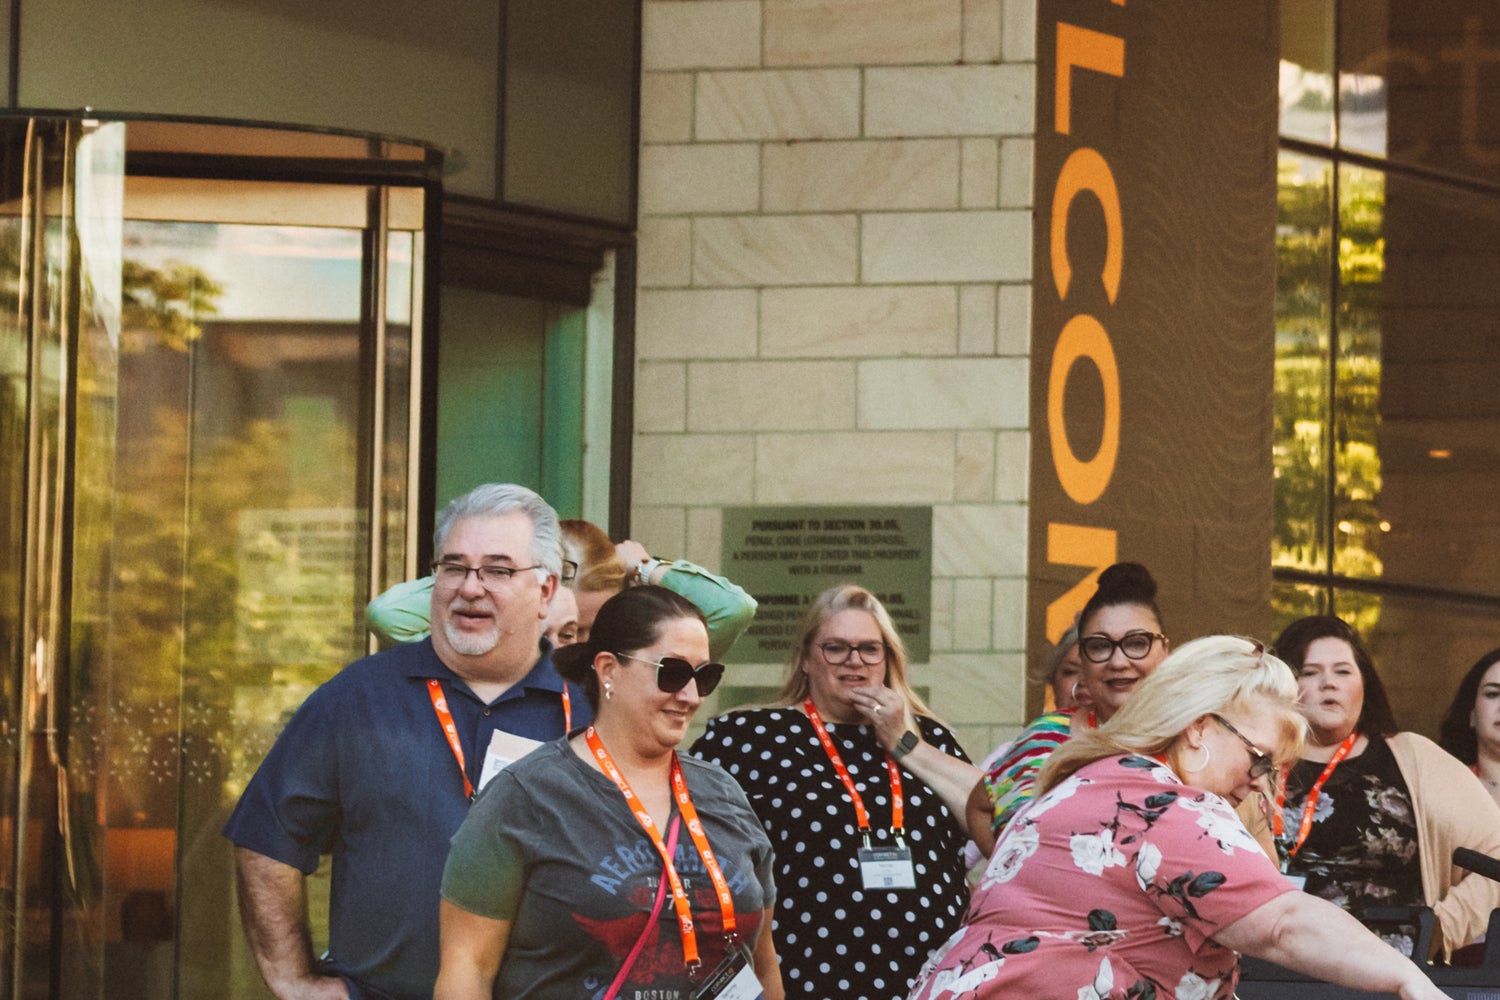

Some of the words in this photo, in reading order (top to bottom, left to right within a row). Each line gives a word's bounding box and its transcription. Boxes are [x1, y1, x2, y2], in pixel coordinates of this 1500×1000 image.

[808, 519, 821, 531] TO
[823, 519, 865, 531] SECTION
[745, 535, 773, 546] PENAL
[776, 535, 802, 546] CODE
[741, 550, 777, 561] PERSON
[780, 550, 799, 560] MAY
[800, 550, 818, 561] NOT
[820, 550, 849, 561] ENTER
[852, 550, 872, 561] THIS
[874, 549, 920, 561] PROPERTY
[789, 564, 811, 575] WITH
